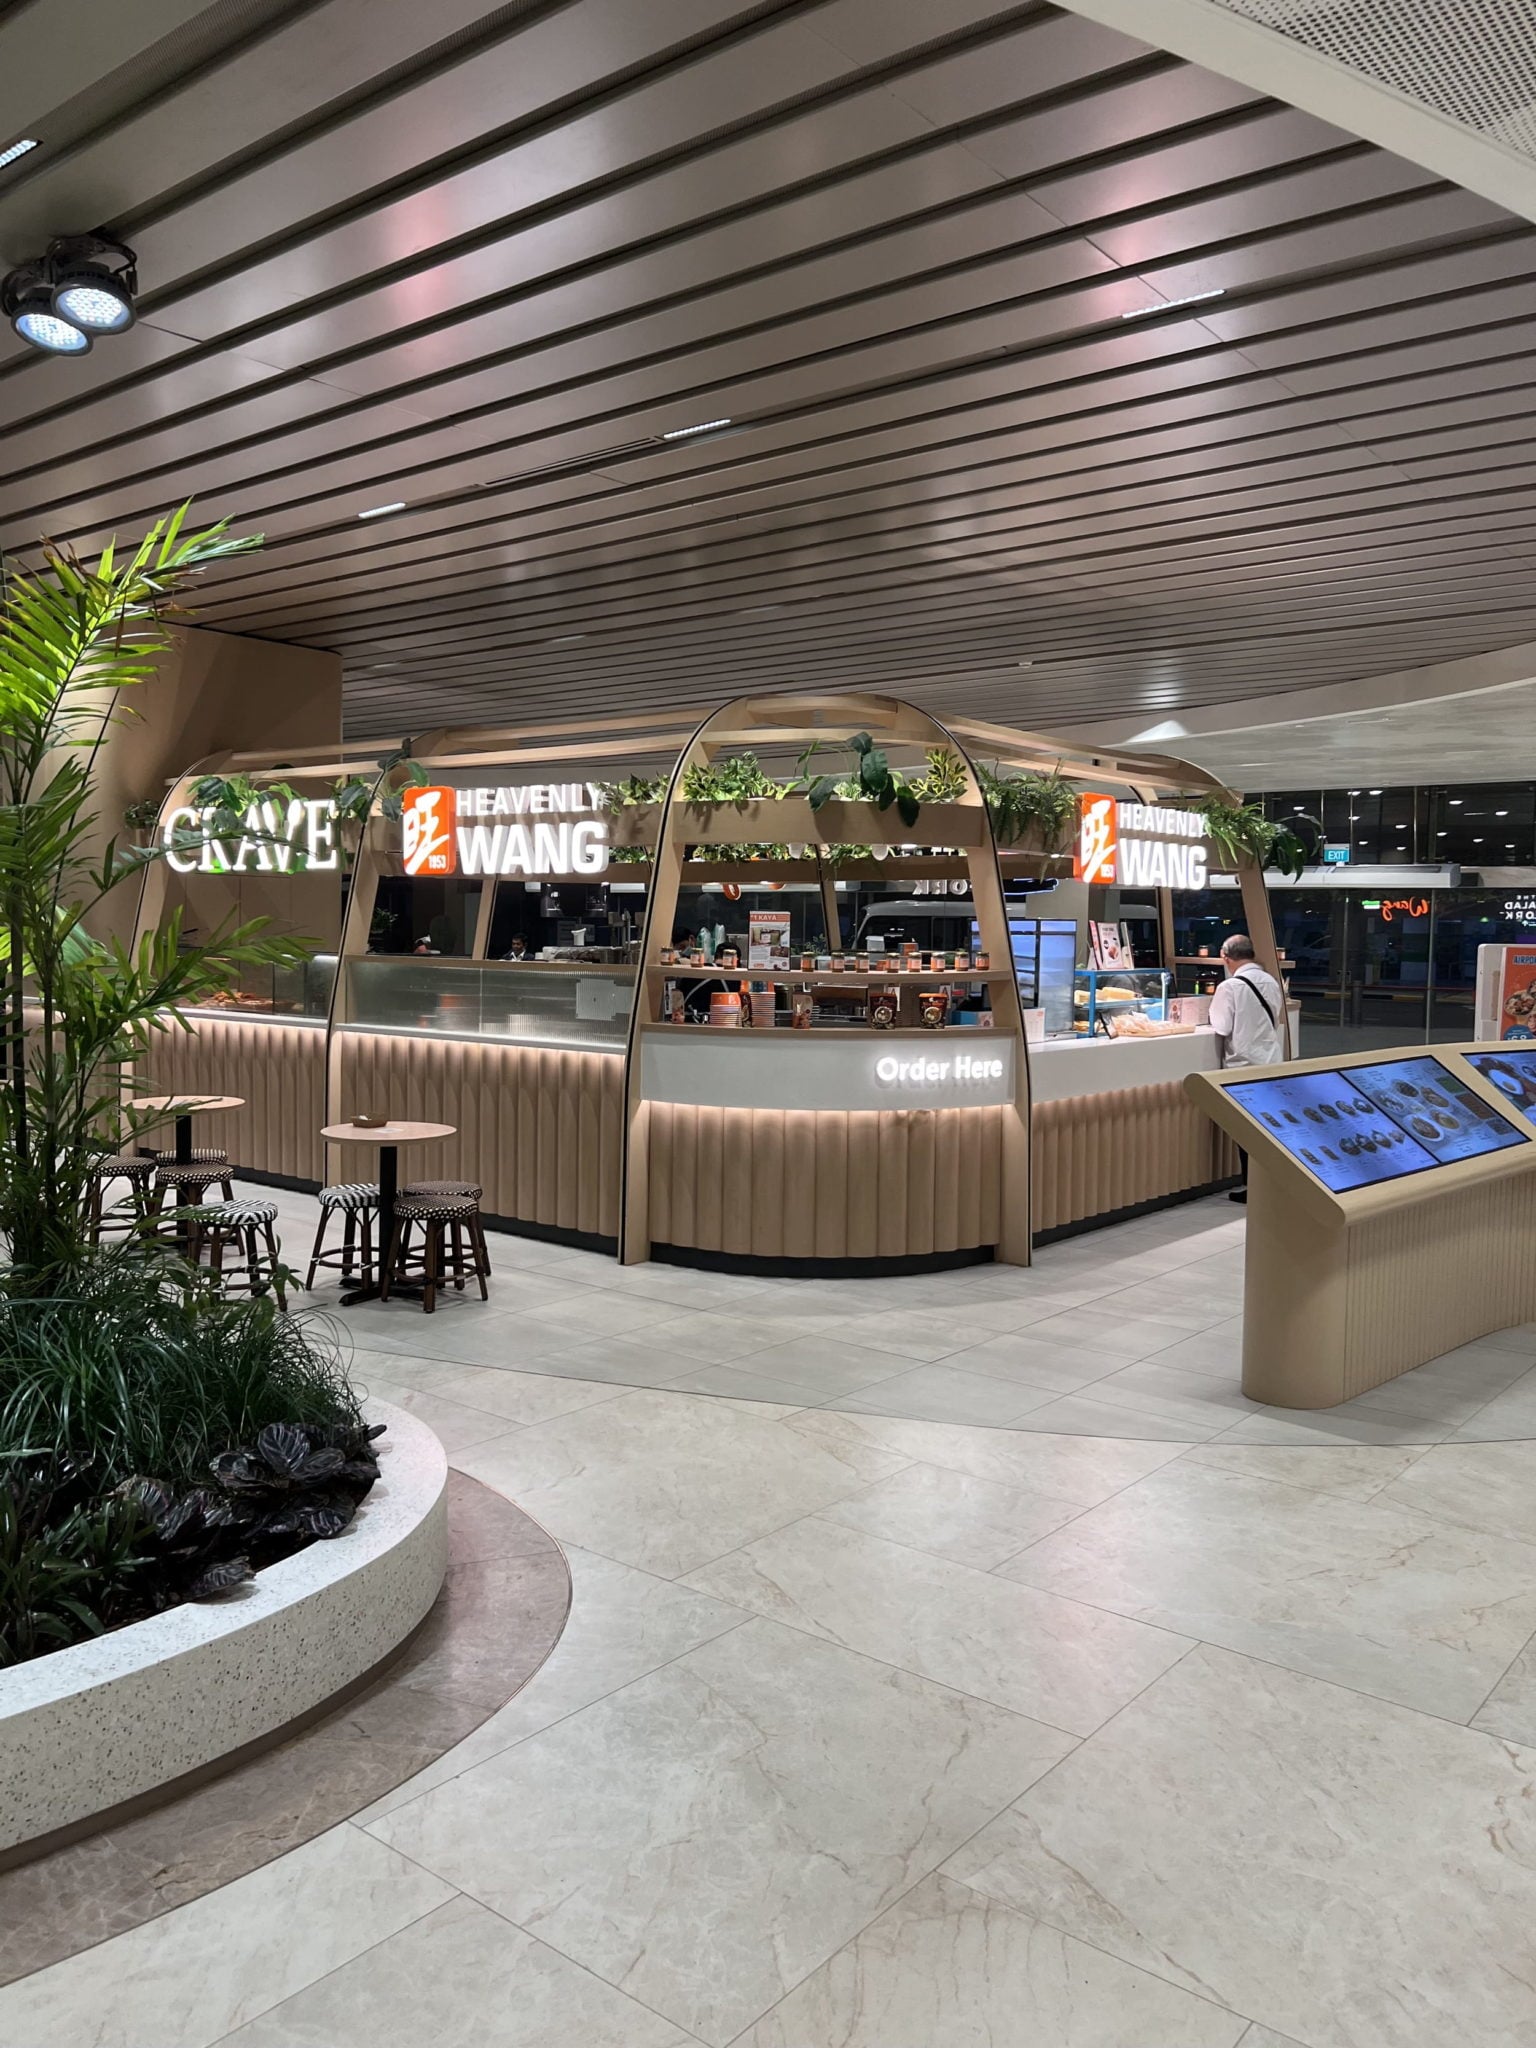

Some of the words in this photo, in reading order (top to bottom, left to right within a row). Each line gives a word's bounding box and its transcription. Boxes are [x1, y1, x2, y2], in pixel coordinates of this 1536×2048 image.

[456, 782, 609, 816] HEAVENLY
[1118, 803, 1207, 838] HEAVENLY
[428, 854, 447, 869] 1953
[456, 821, 609, 875] WANG
[1118, 838, 1207, 890] WANG
[1328, 851, 1345, 860] EXIT
[876, 1057, 950, 1081] Order
[955, 1056, 1003, 1079] Here
